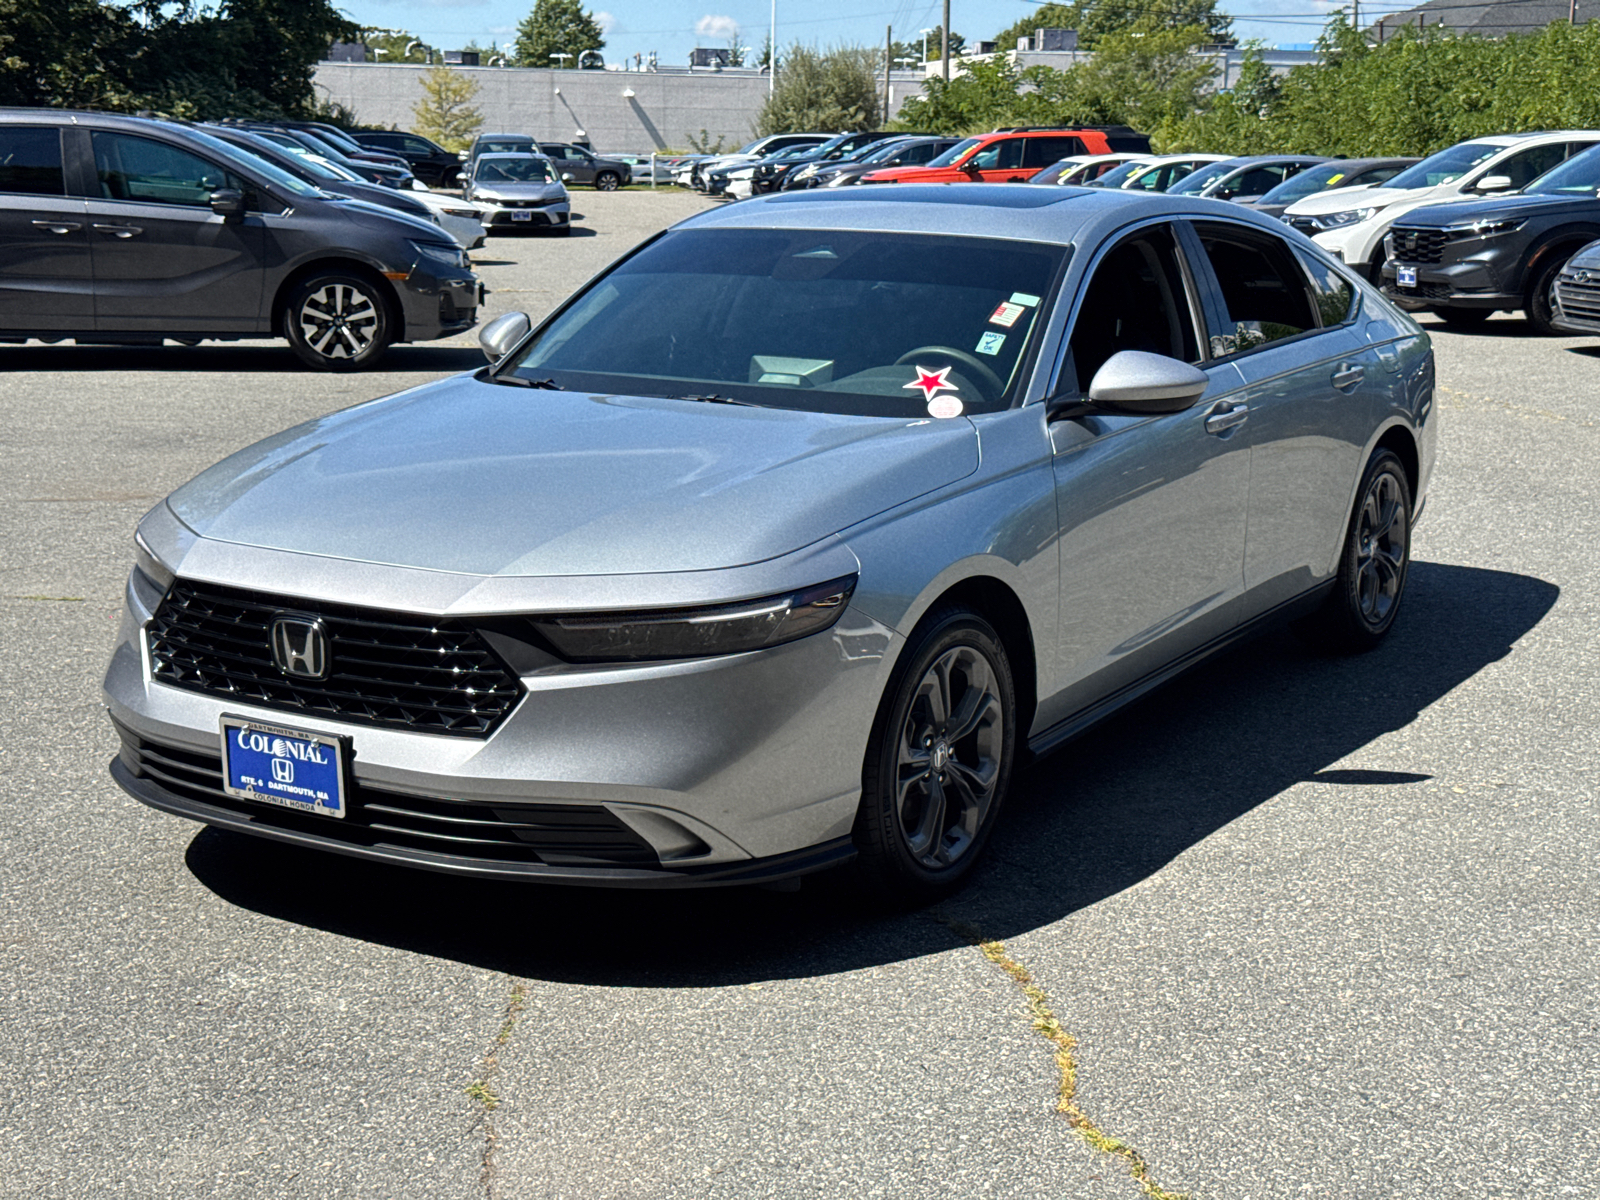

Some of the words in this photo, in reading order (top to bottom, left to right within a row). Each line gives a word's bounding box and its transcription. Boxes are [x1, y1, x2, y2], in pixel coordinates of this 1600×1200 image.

[237, 730, 328, 764] COLONIAL
[240, 775, 257, 786] RTE.
[258, 779, 264, 787] 6
[268, 781, 316, 799] DARTMOUTH,
[316, 790, 329, 800] MA
[254, 793, 288, 806] COLONIAL
[289, 800, 315, 811] HONDA
